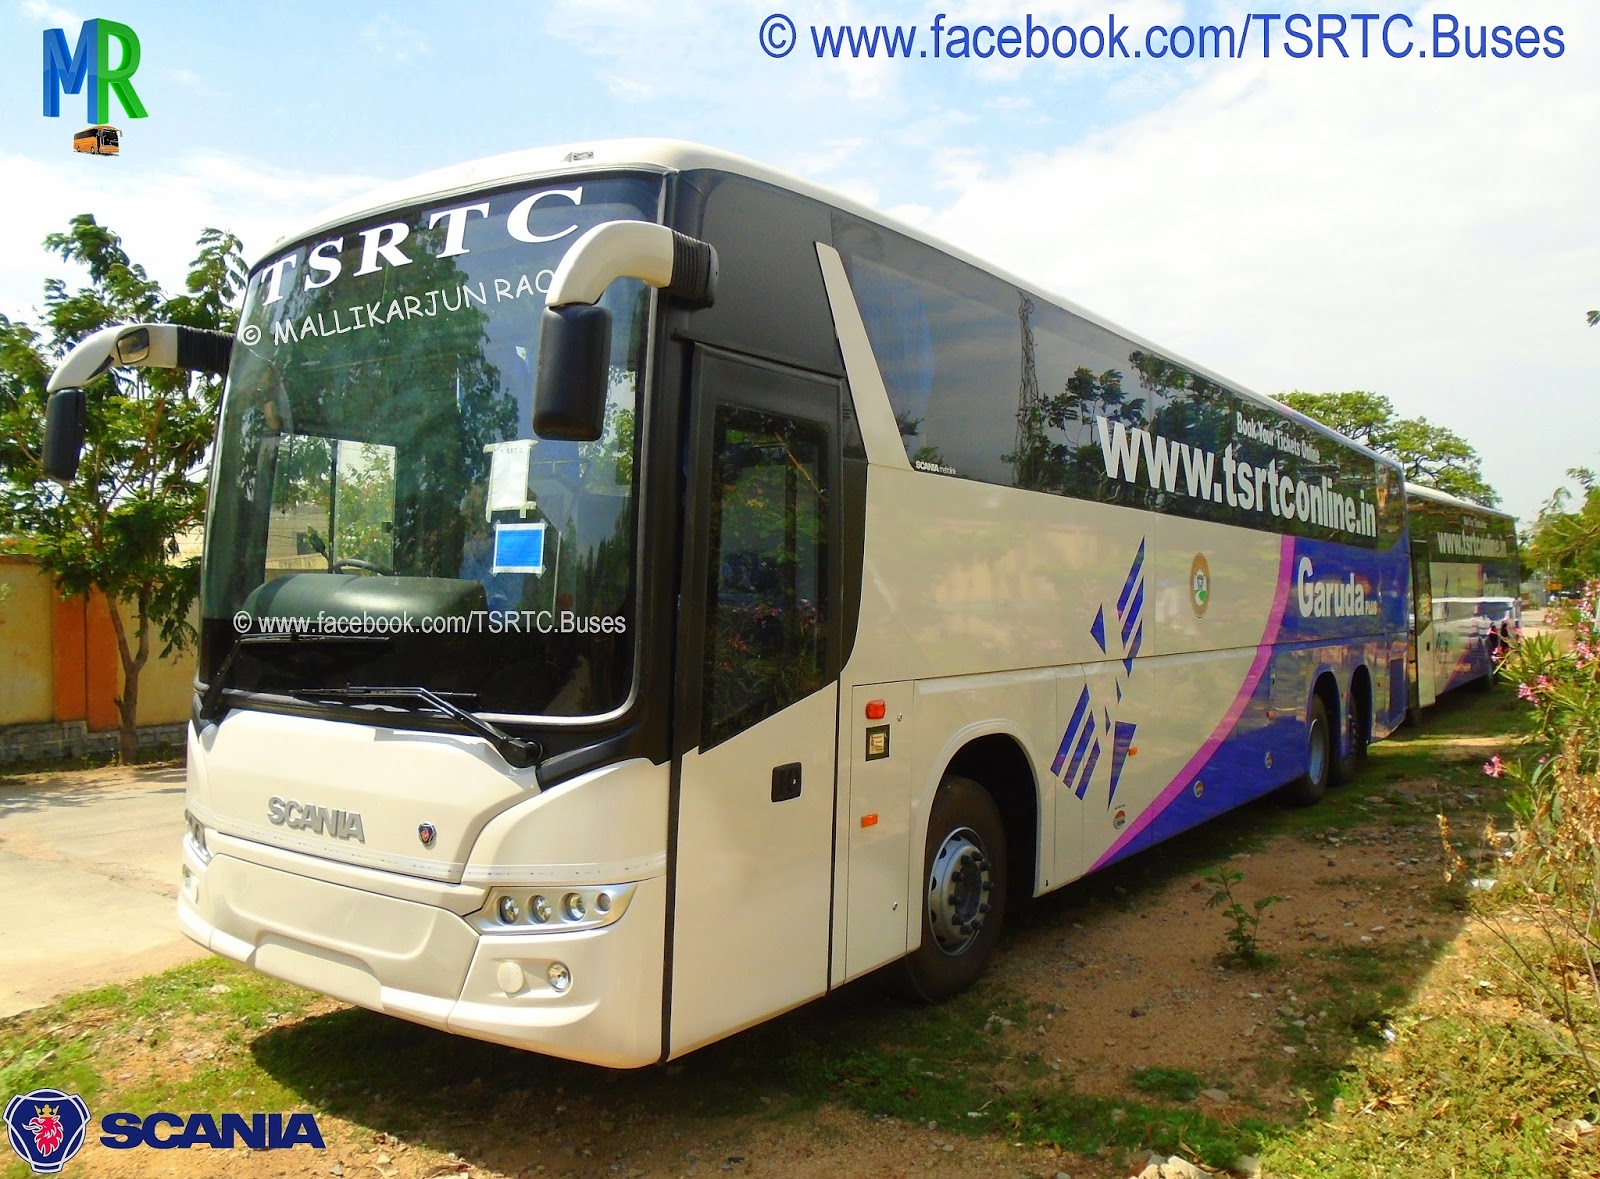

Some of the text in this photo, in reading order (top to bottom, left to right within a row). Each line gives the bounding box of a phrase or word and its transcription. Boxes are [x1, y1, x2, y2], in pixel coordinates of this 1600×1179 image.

[260, 186, 584, 306] TSRTC
[1236, 411, 1257, 439] Book
[915, 460, 940, 473] SCANIA
[1097, 416, 1377, 537] www.tsrtconline.in
[1298, 557, 1366, 617] Garuda
[267, 796, 366, 844] SCANIA
